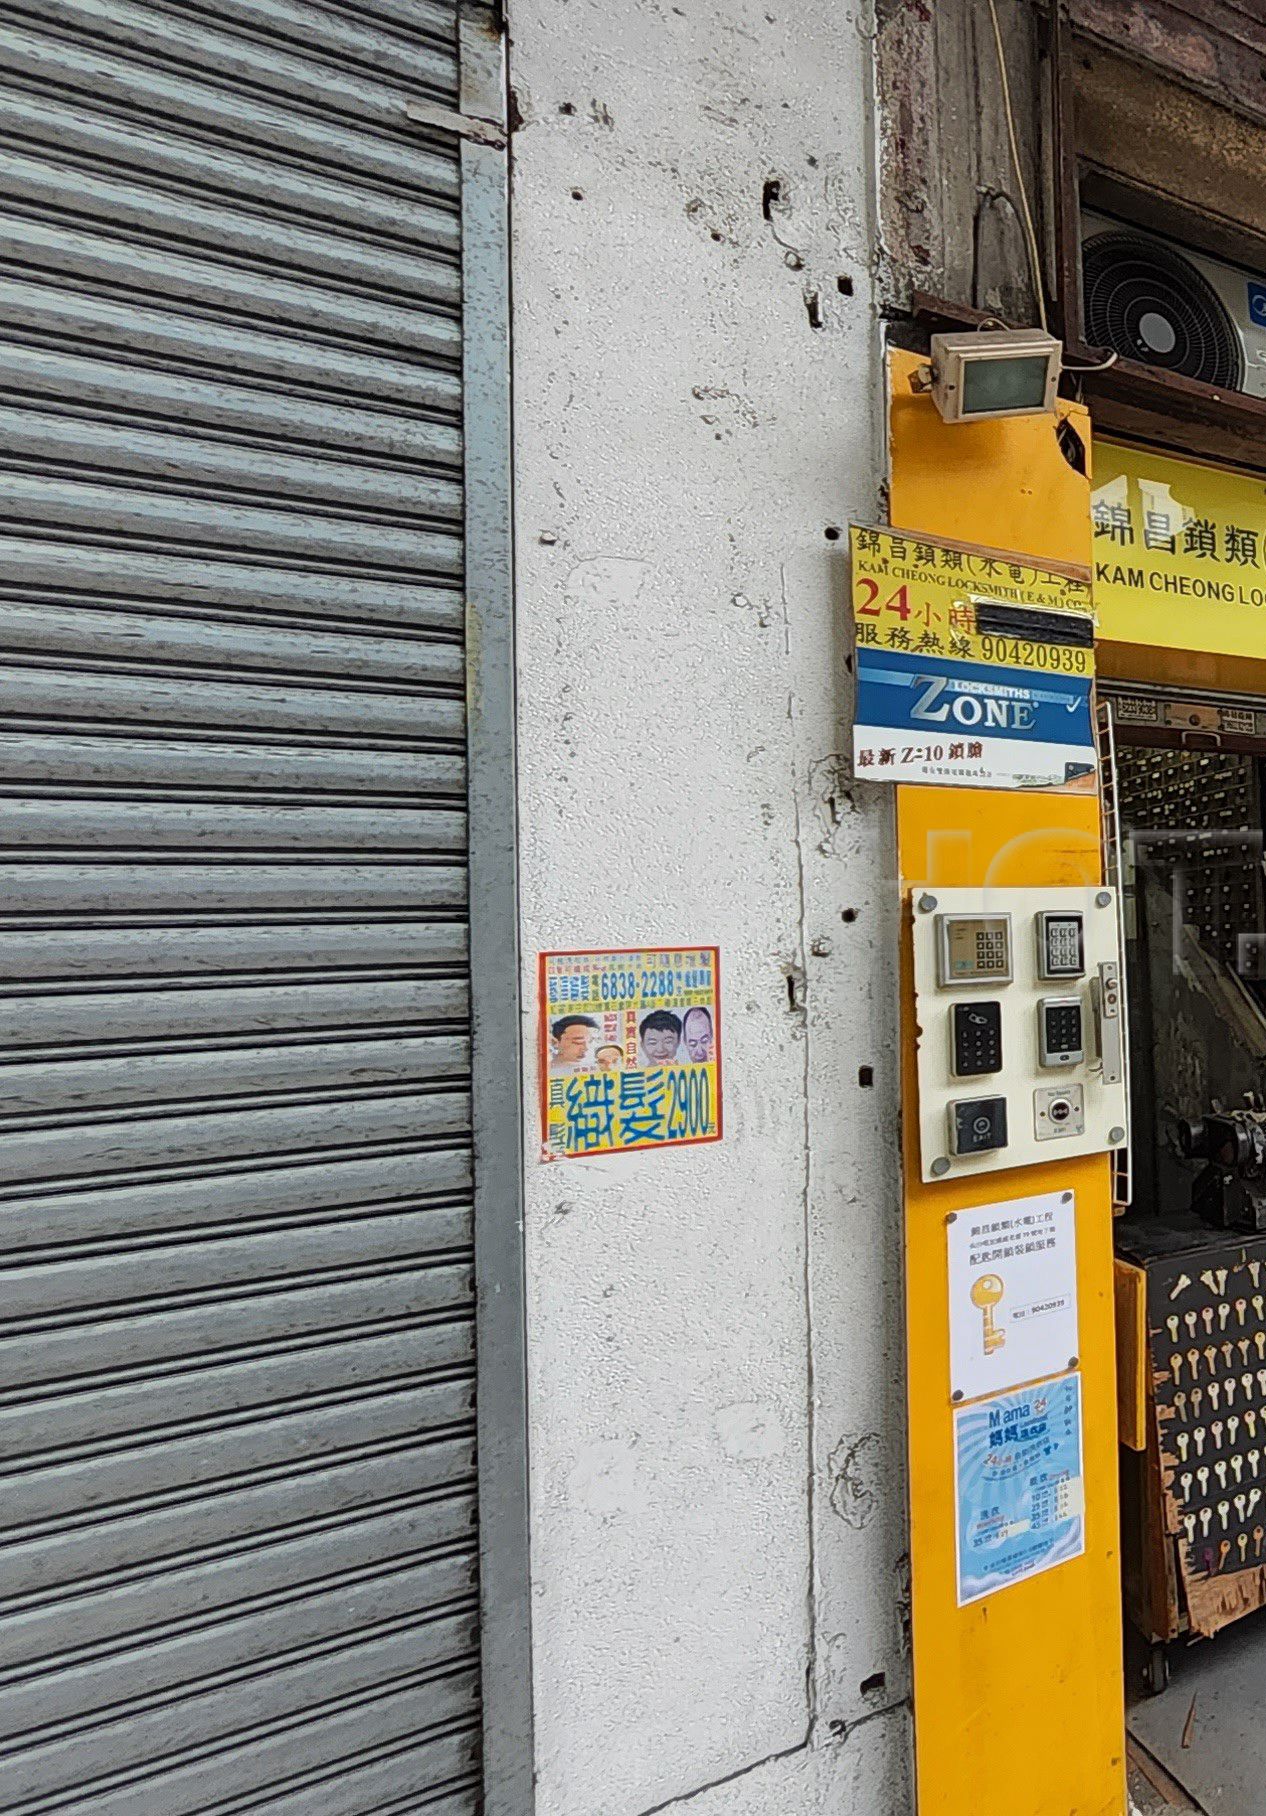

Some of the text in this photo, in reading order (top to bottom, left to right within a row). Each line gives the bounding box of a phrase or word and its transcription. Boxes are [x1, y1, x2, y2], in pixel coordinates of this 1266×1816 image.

[858, 559, 889, 576] KAM
[891, 566, 946, 586] CHEONG
[947, 577, 1018, 599] LOCKSMITH
[1096, 562, 1145, 589] KAM
[1149, 570, 1235, 602] CHEONG
[856, 622, 1087, 671] 服務熱線 90420939
[909, 673, 1038, 731] ZONE
[951, 679, 1032, 700] LOCKSMITHS
[667, 1067, 709, 1139] 2900
